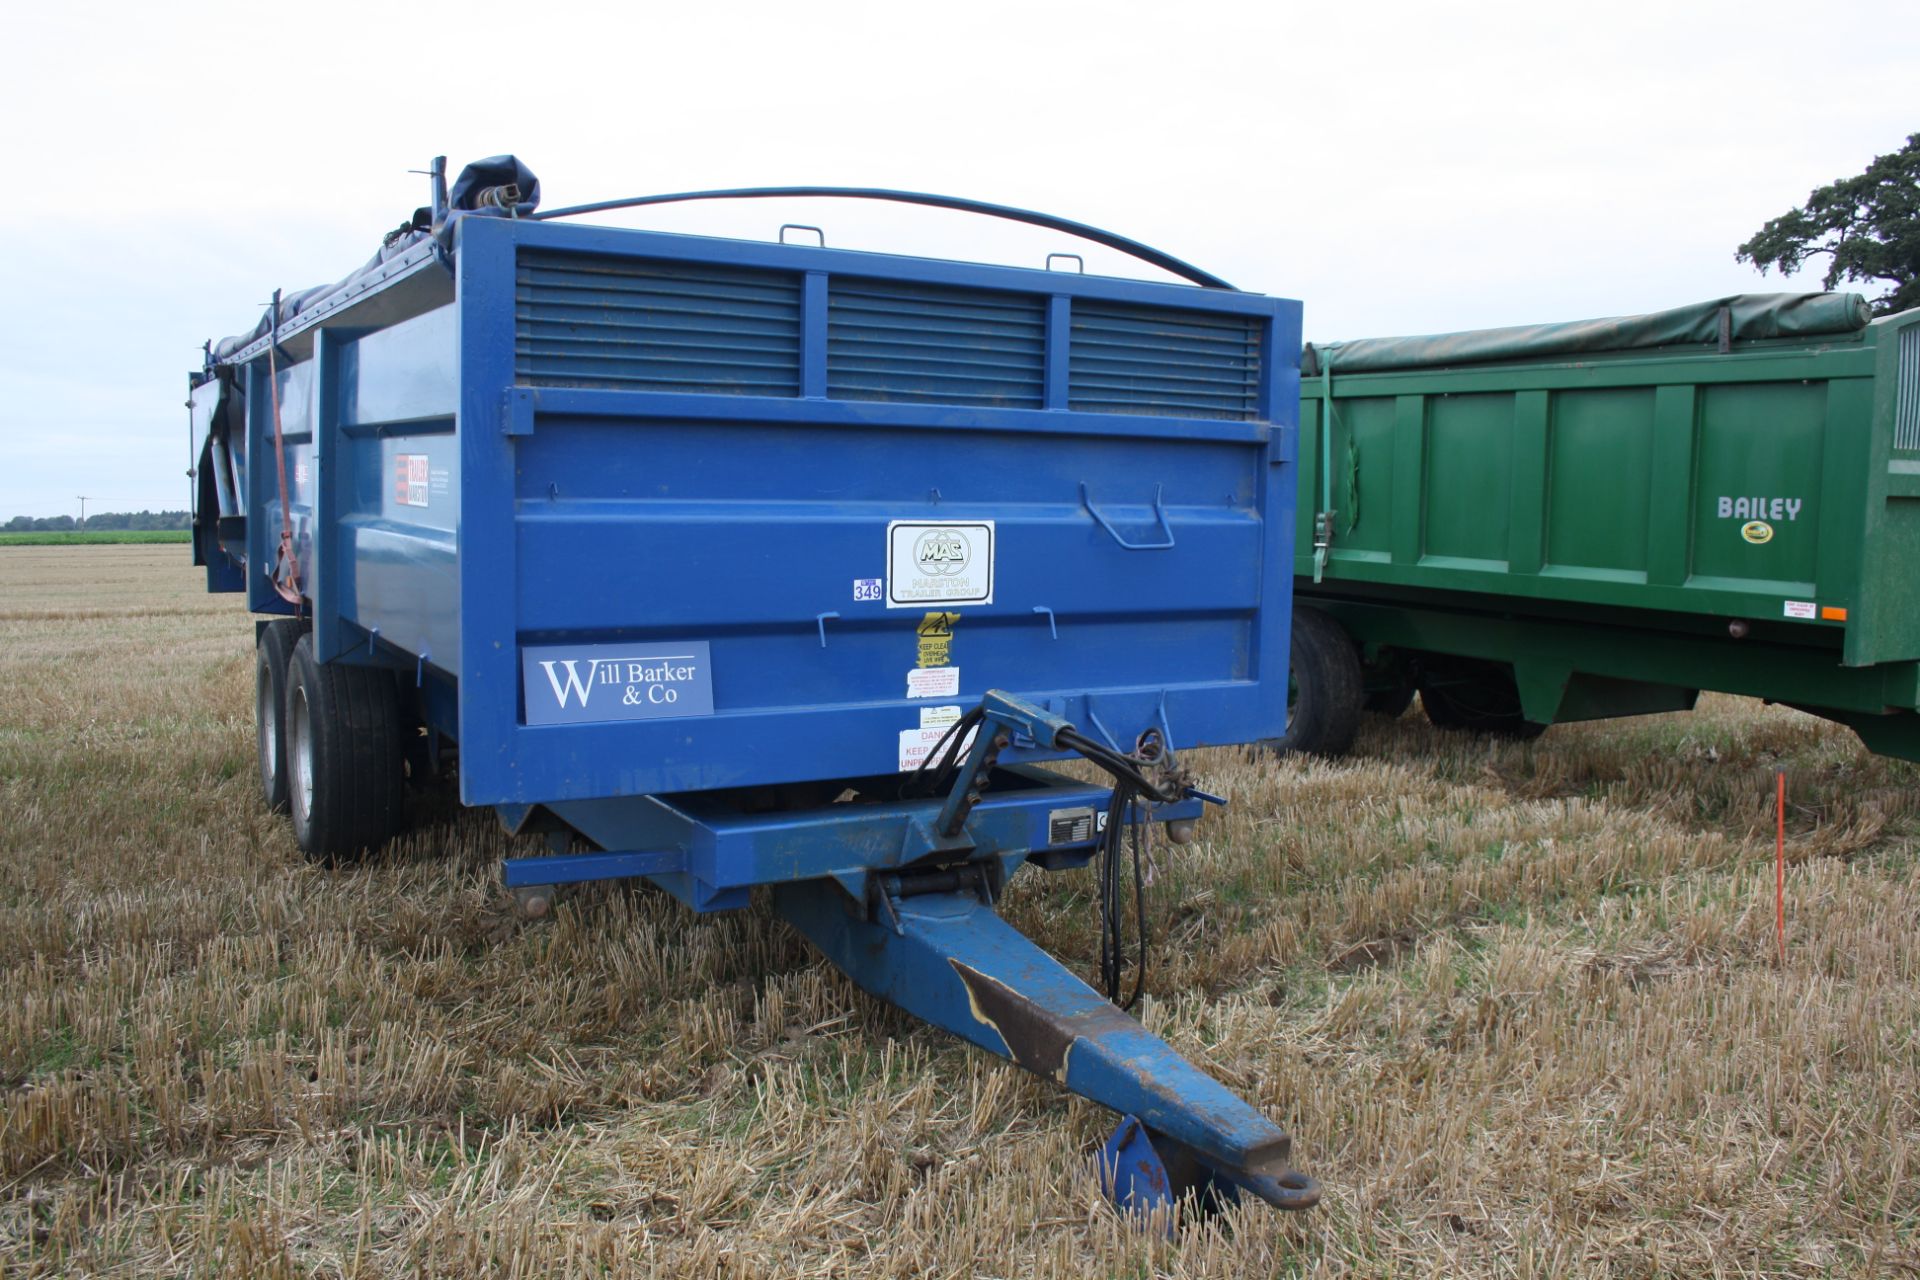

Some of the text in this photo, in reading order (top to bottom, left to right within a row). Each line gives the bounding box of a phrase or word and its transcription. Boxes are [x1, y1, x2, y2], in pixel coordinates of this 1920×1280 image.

[1718, 496, 1801, 521] BAILEY
[920, 541, 964, 562] MAS
[855, 585, 881, 600] 349
[900, 587, 980, 598] TRAILER GROUP
[538, 659, 696, 709] Will Barker
[622, 684, 677, 706] & Co
[906, 746, 928, 757] KEEP
